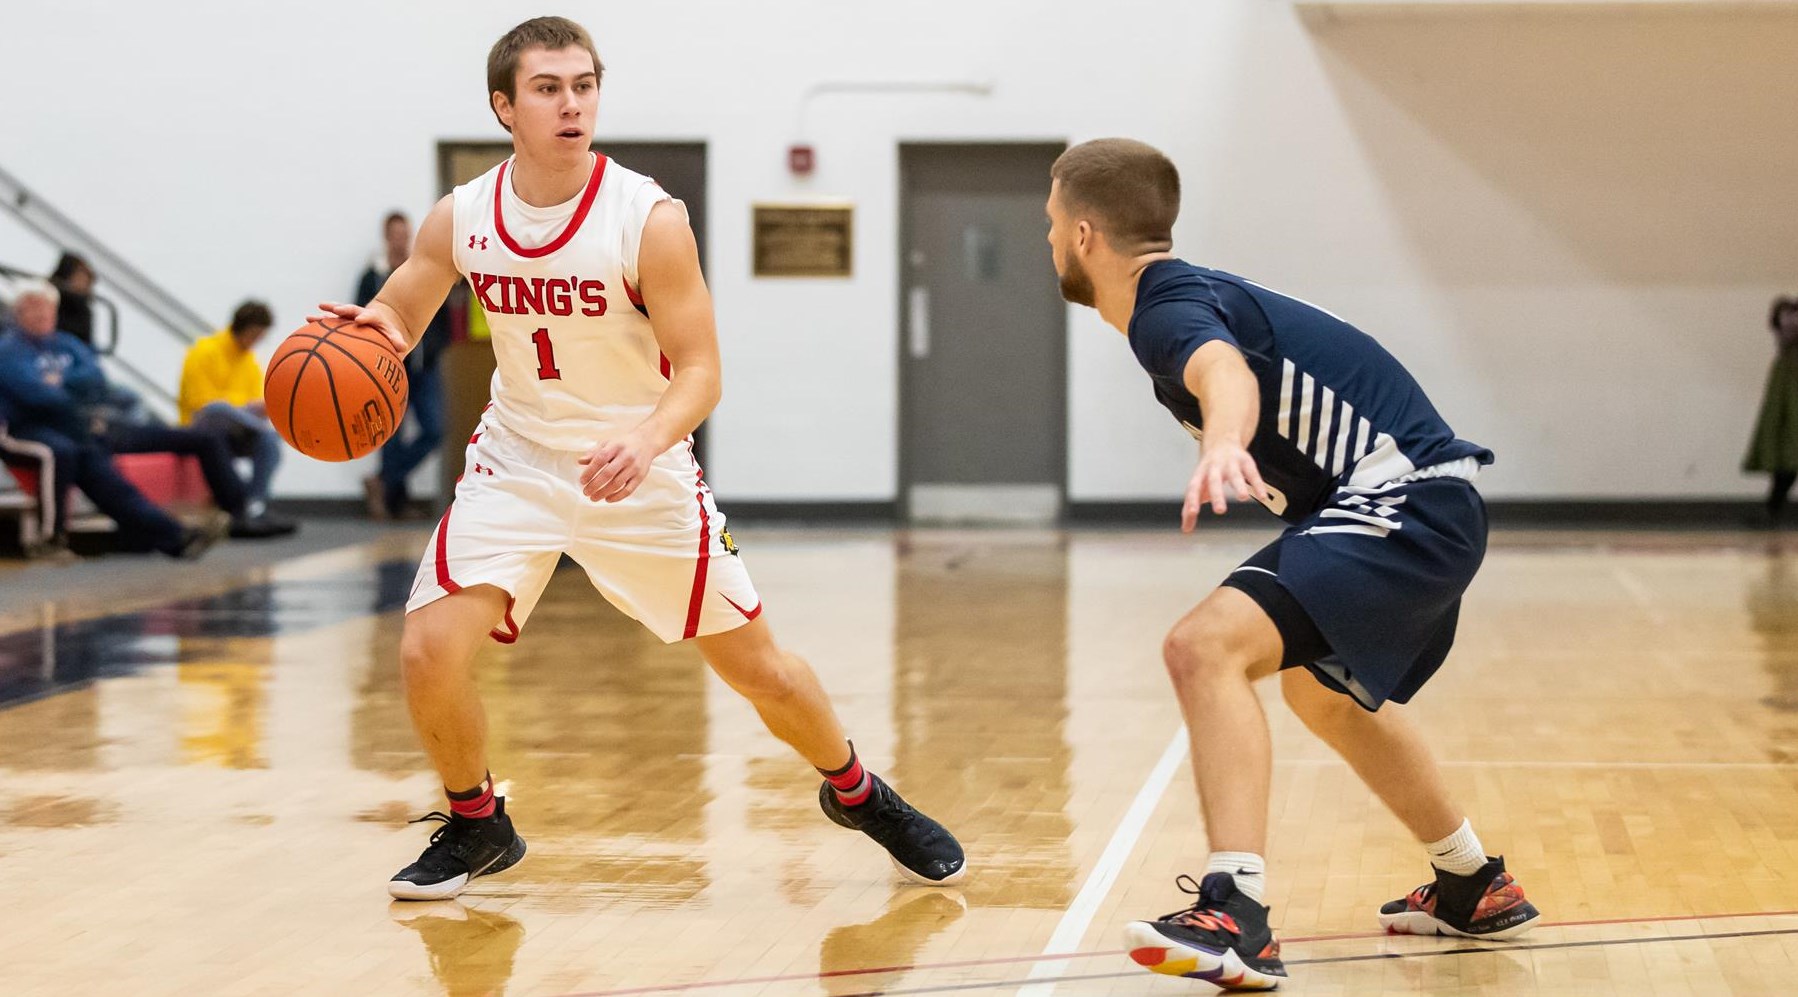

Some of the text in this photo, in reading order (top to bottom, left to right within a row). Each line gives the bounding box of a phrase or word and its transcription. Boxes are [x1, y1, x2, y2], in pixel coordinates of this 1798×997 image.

[470, 271, 607, 317] KING'S
[375, 354, 404, 395] THE
[531, 328, 561, 380] 1
